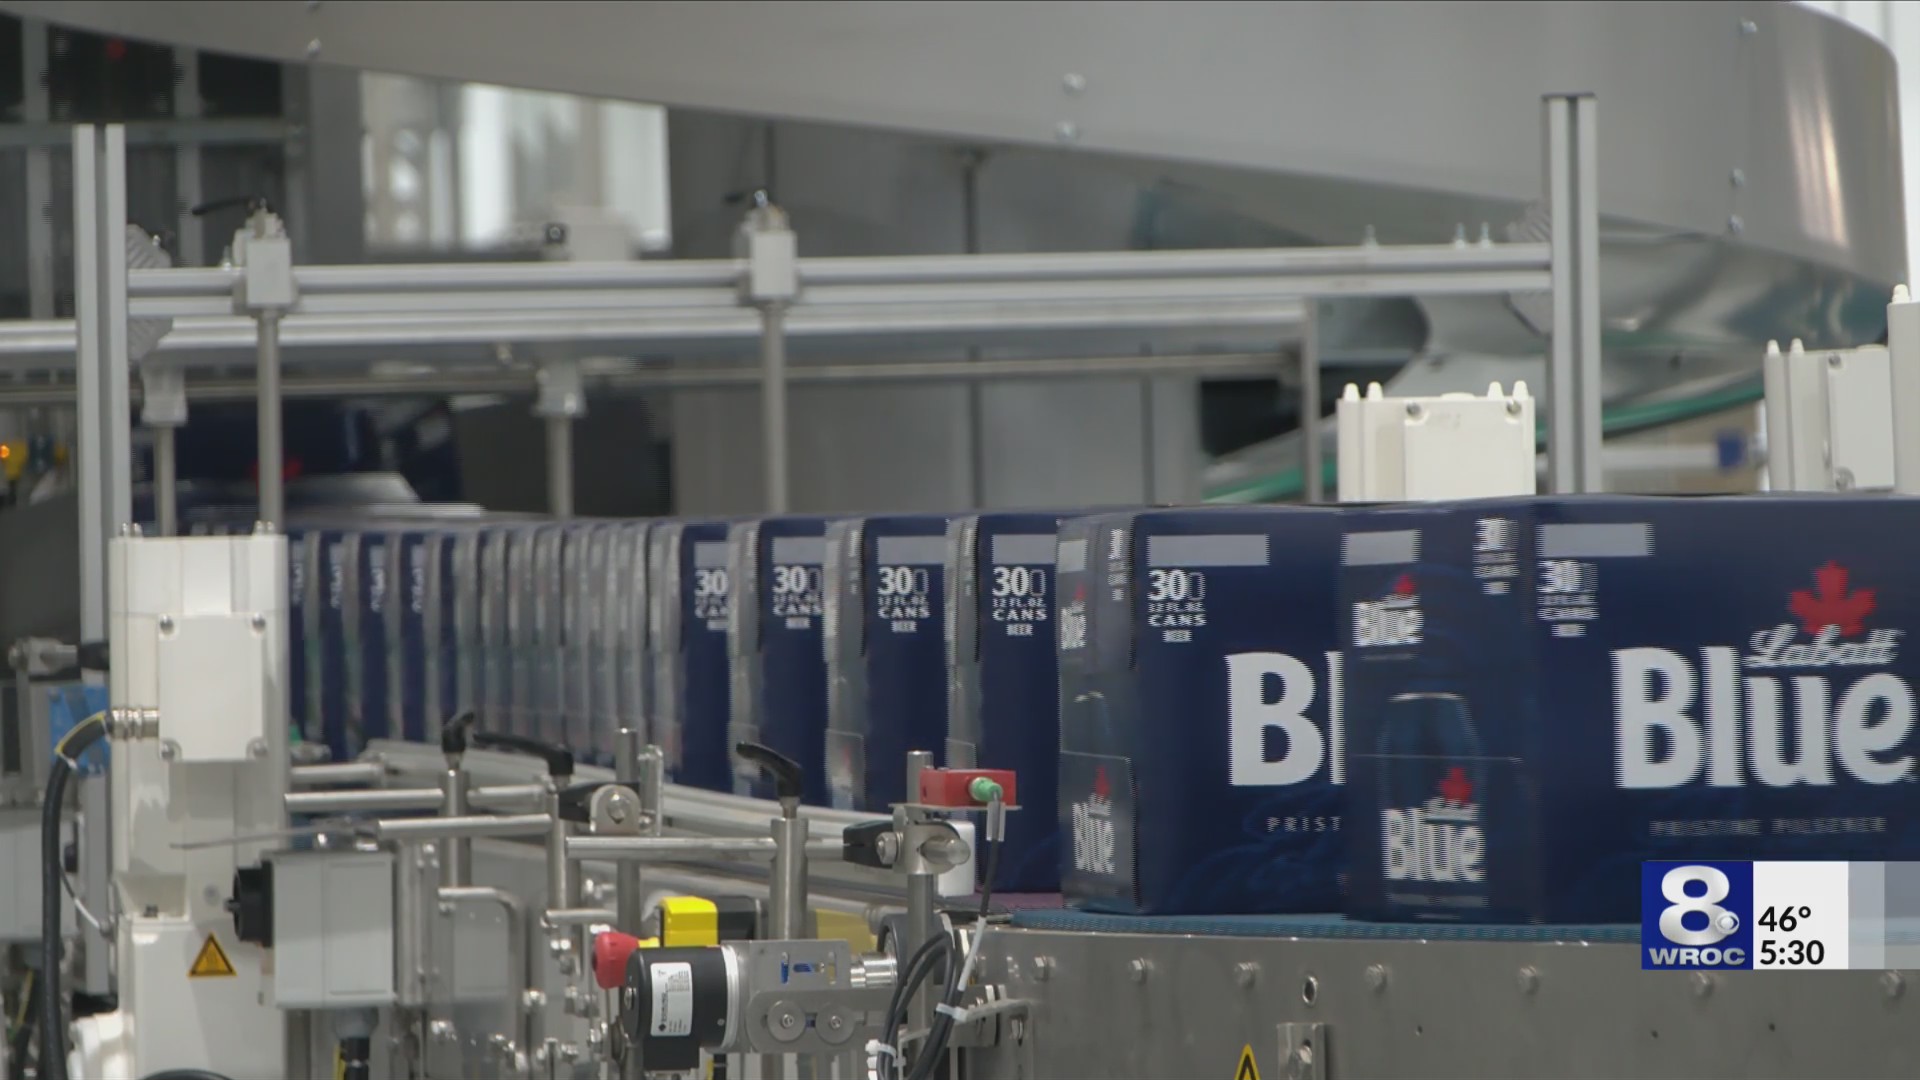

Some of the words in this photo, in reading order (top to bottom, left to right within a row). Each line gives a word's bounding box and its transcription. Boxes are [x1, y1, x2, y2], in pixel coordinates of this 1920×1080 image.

[695, 569, 728, 596] 30
[773, 566, 807, 593] 30
[878, 566, 913, 595] 30
[992, 566, 1029, 596] 30
[1148, 569, 1188, 600] 30
[1536, 561, 1582, 593] 30
[878, 607, 930, 619] CANS
[992, 609, 1047, 621] CANS
[1148, 614, 1206, 626] CANS
[1353, 601, 1424, 646] Blue
[1536, 607, 1599, 620] CANS
[1743, 624, 1900, 668] Labatt
[1609, 646, 1917, 788] Blue
[1267, 816, 1342, 832] PRIST
[1379, 808, 1487, 882] Blue
